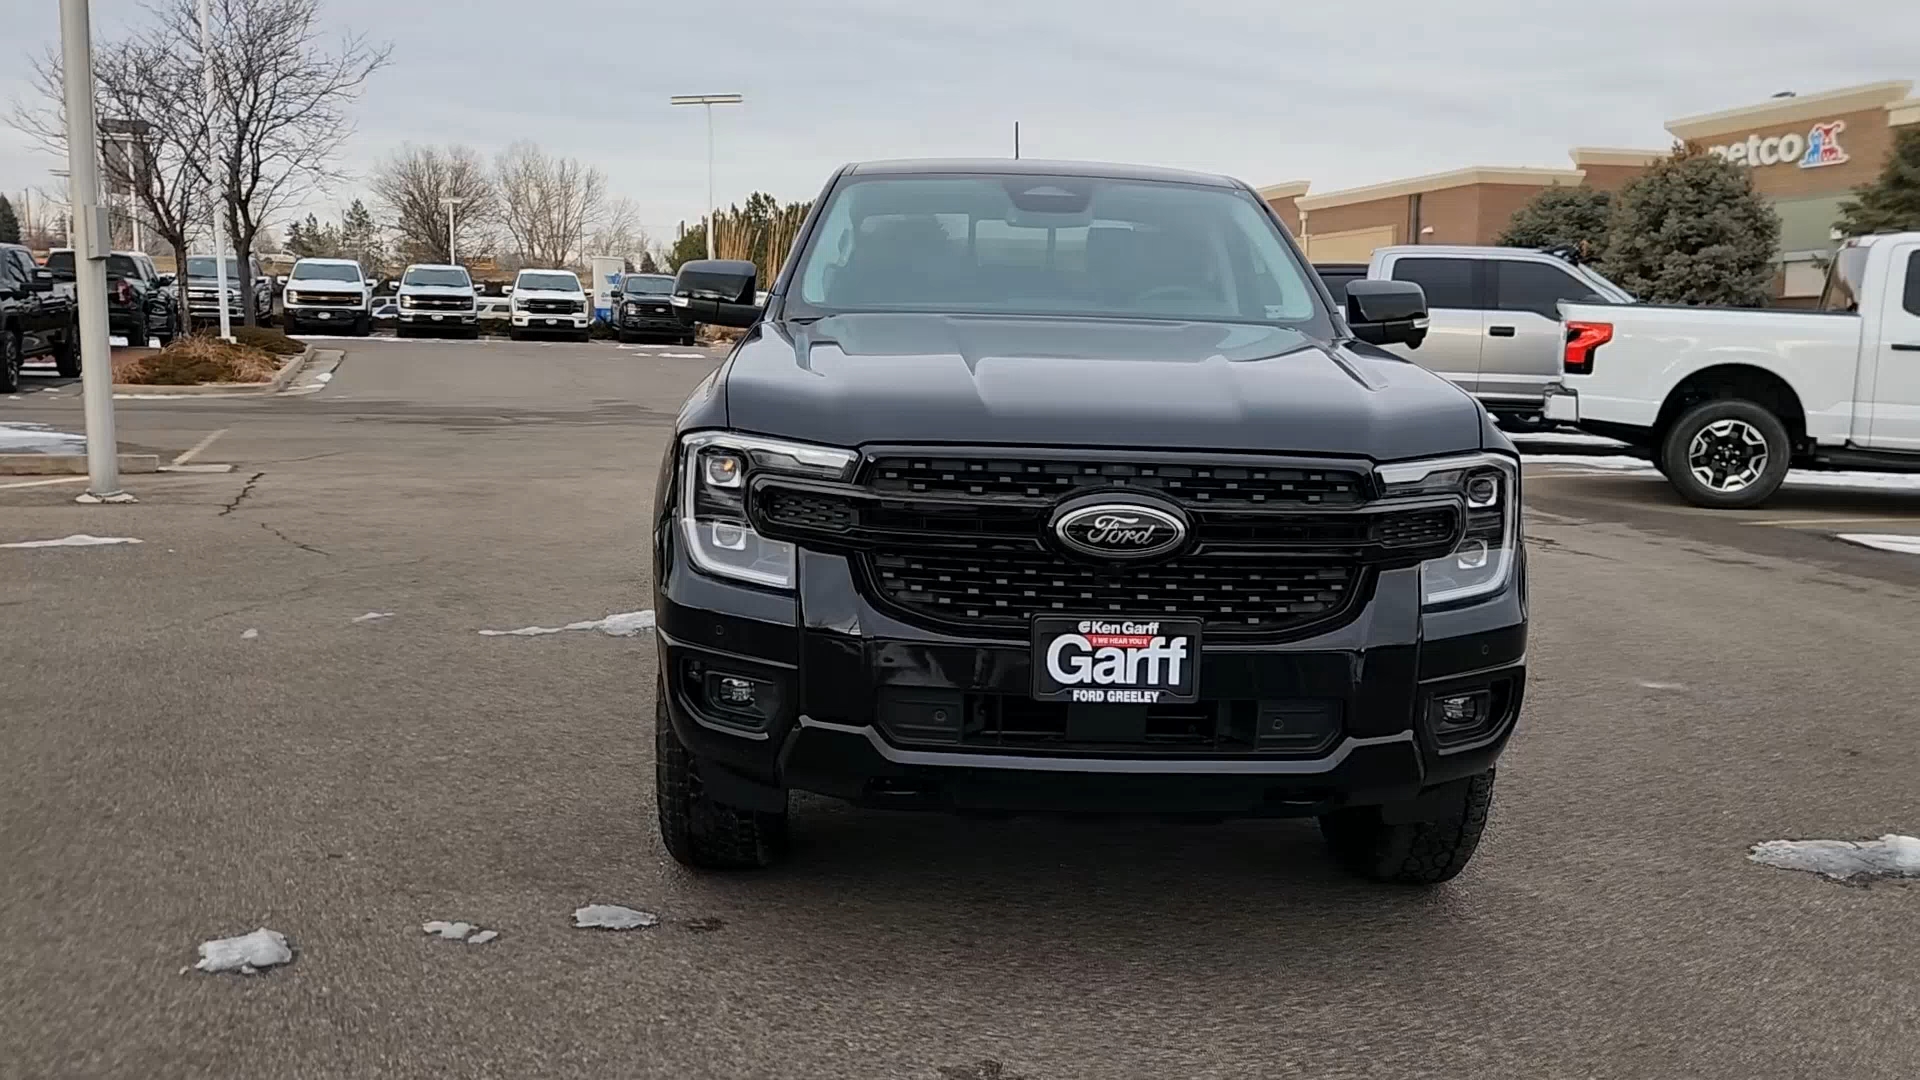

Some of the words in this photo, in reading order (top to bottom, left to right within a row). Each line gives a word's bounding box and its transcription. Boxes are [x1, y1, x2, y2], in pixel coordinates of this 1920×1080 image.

[1087, 515, 1156, 545] Ford
[1091, 621, 1120, 634] Ken
[1121, 621, 1160, 635] Garff
[1109, 637, 1128, 645] HEAR
[1046, 633, 1187, 686] Garff
[1072, 689, 1105, 702] FORD
[1106, 690, 1160, 703] GREELEY
